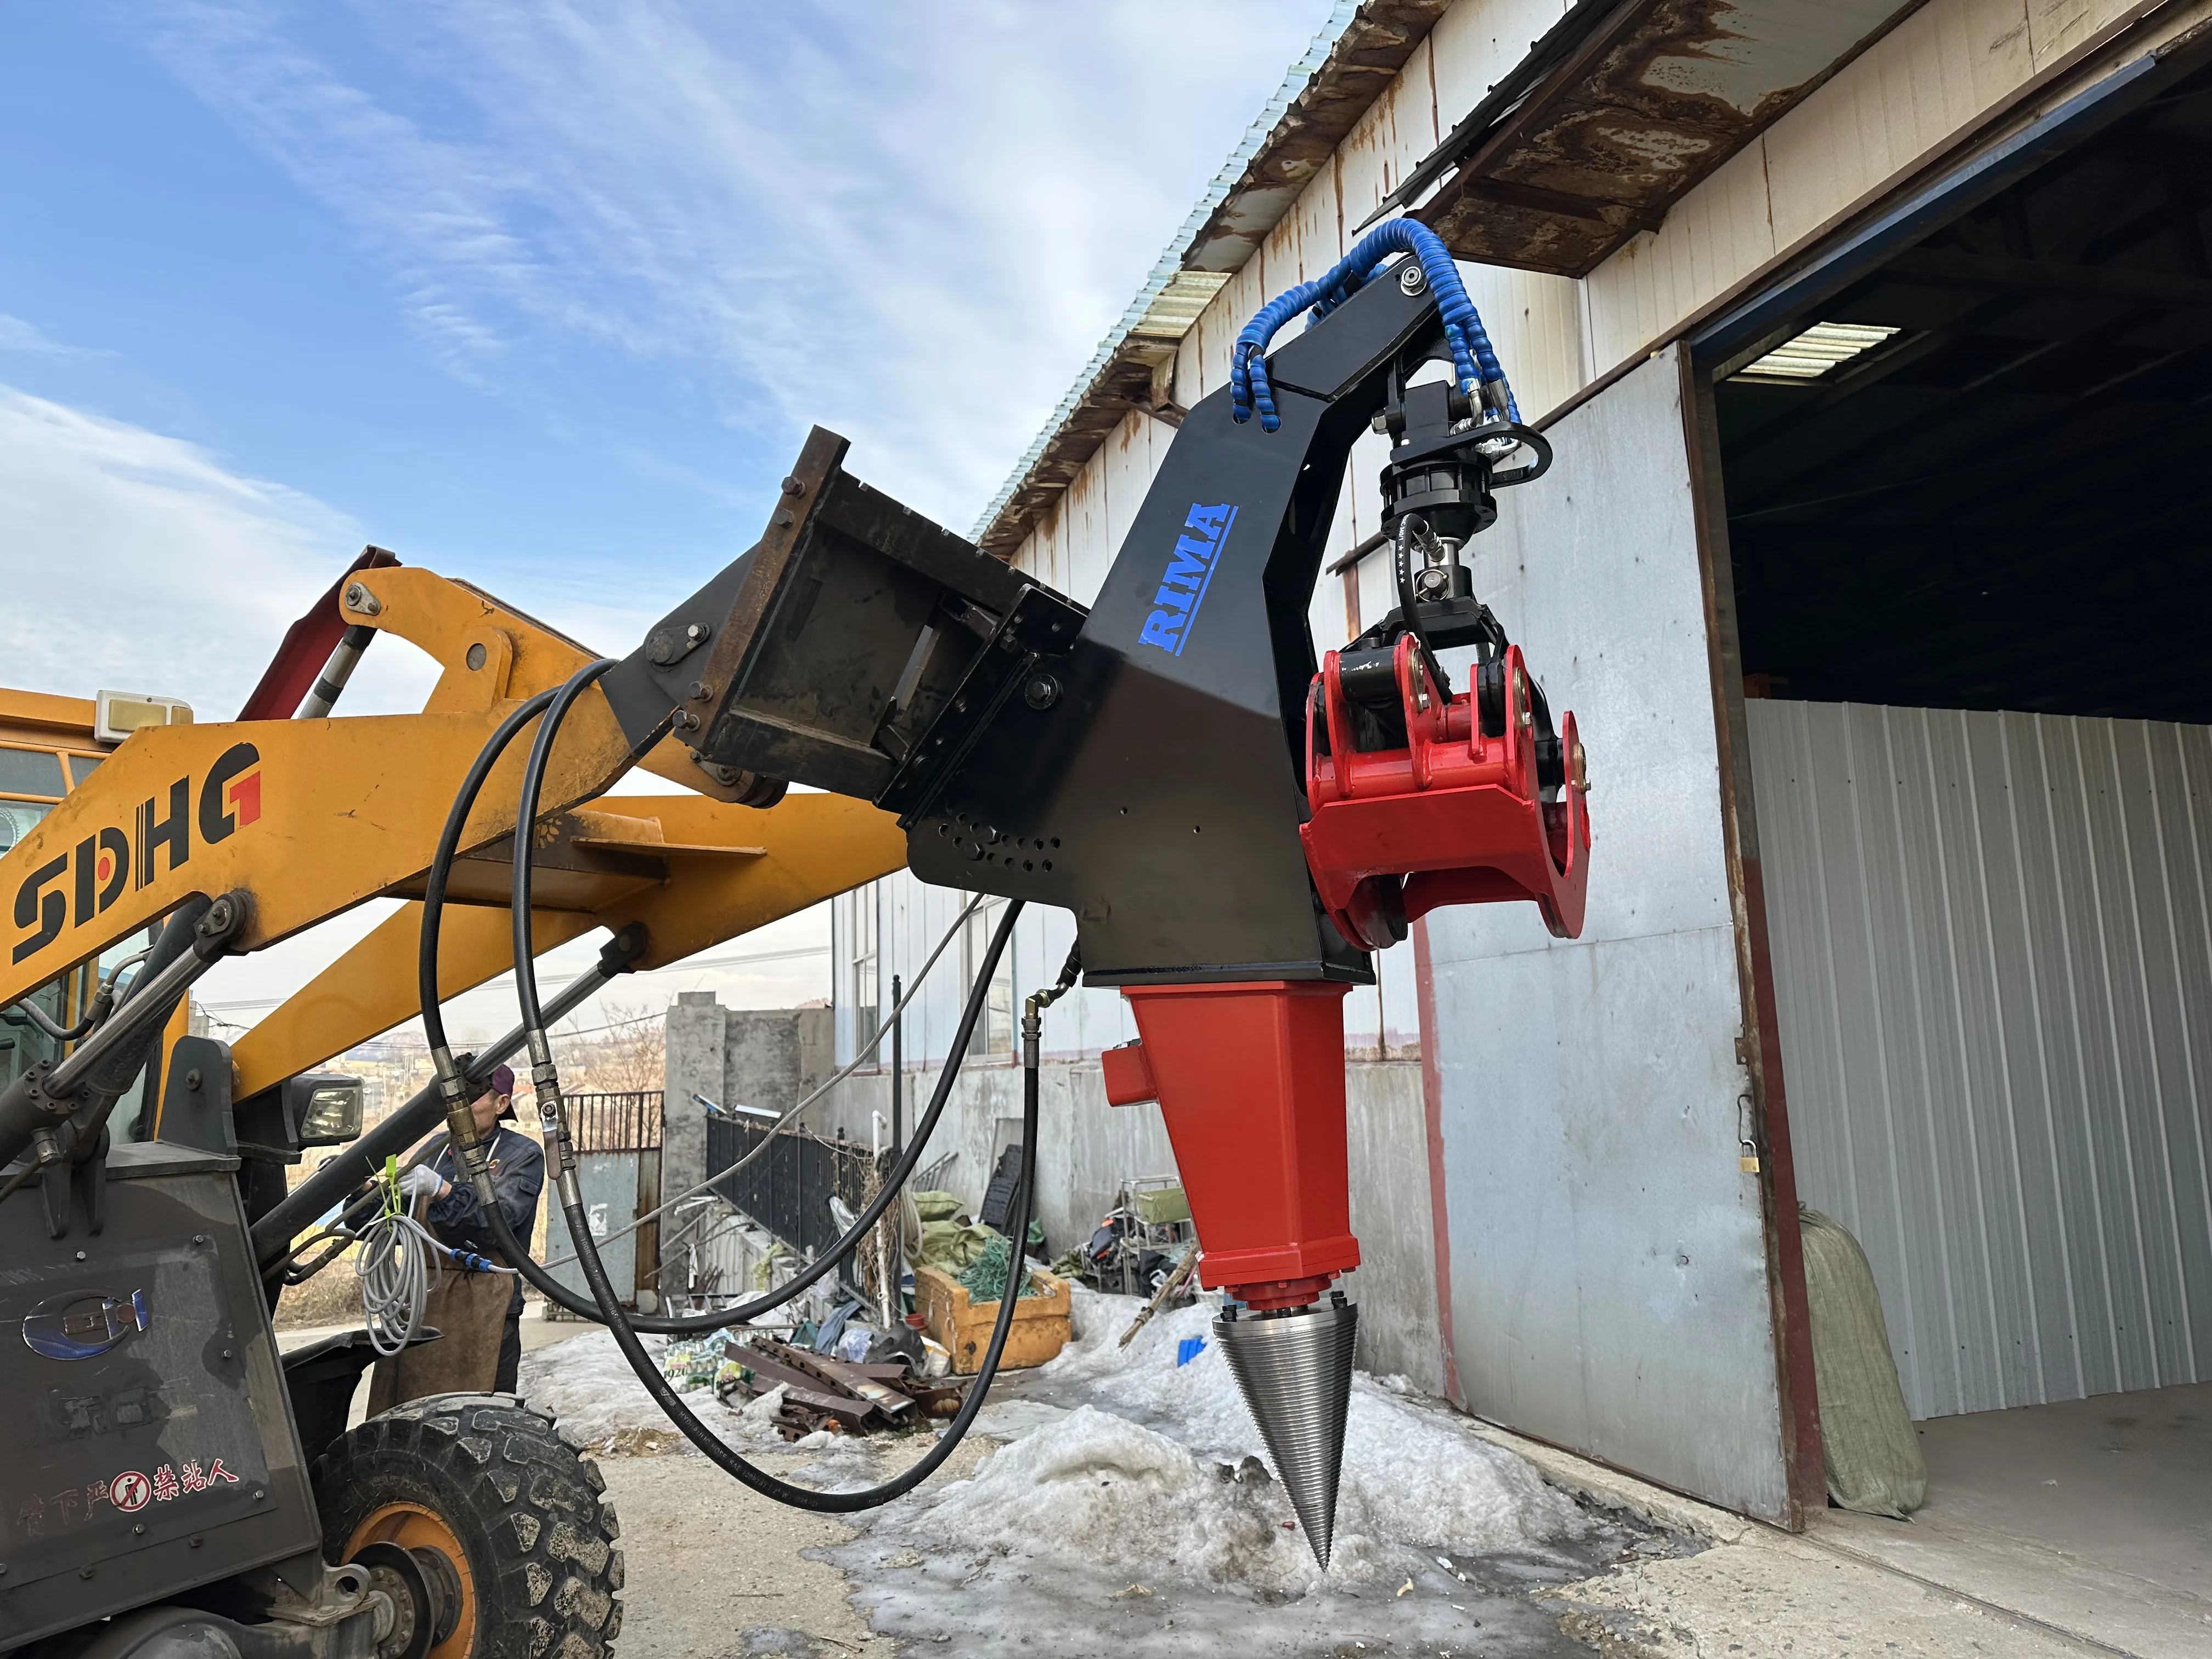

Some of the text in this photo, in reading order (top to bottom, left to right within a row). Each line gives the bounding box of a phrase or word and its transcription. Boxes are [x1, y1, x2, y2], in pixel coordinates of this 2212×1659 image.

[1138, 503, 1231, 652] RIMA
[12, 742, 261, 966] SDHG
[710, 1443, 727, 1459] HOSE
[729, 1460, 741, 1471] SAE
